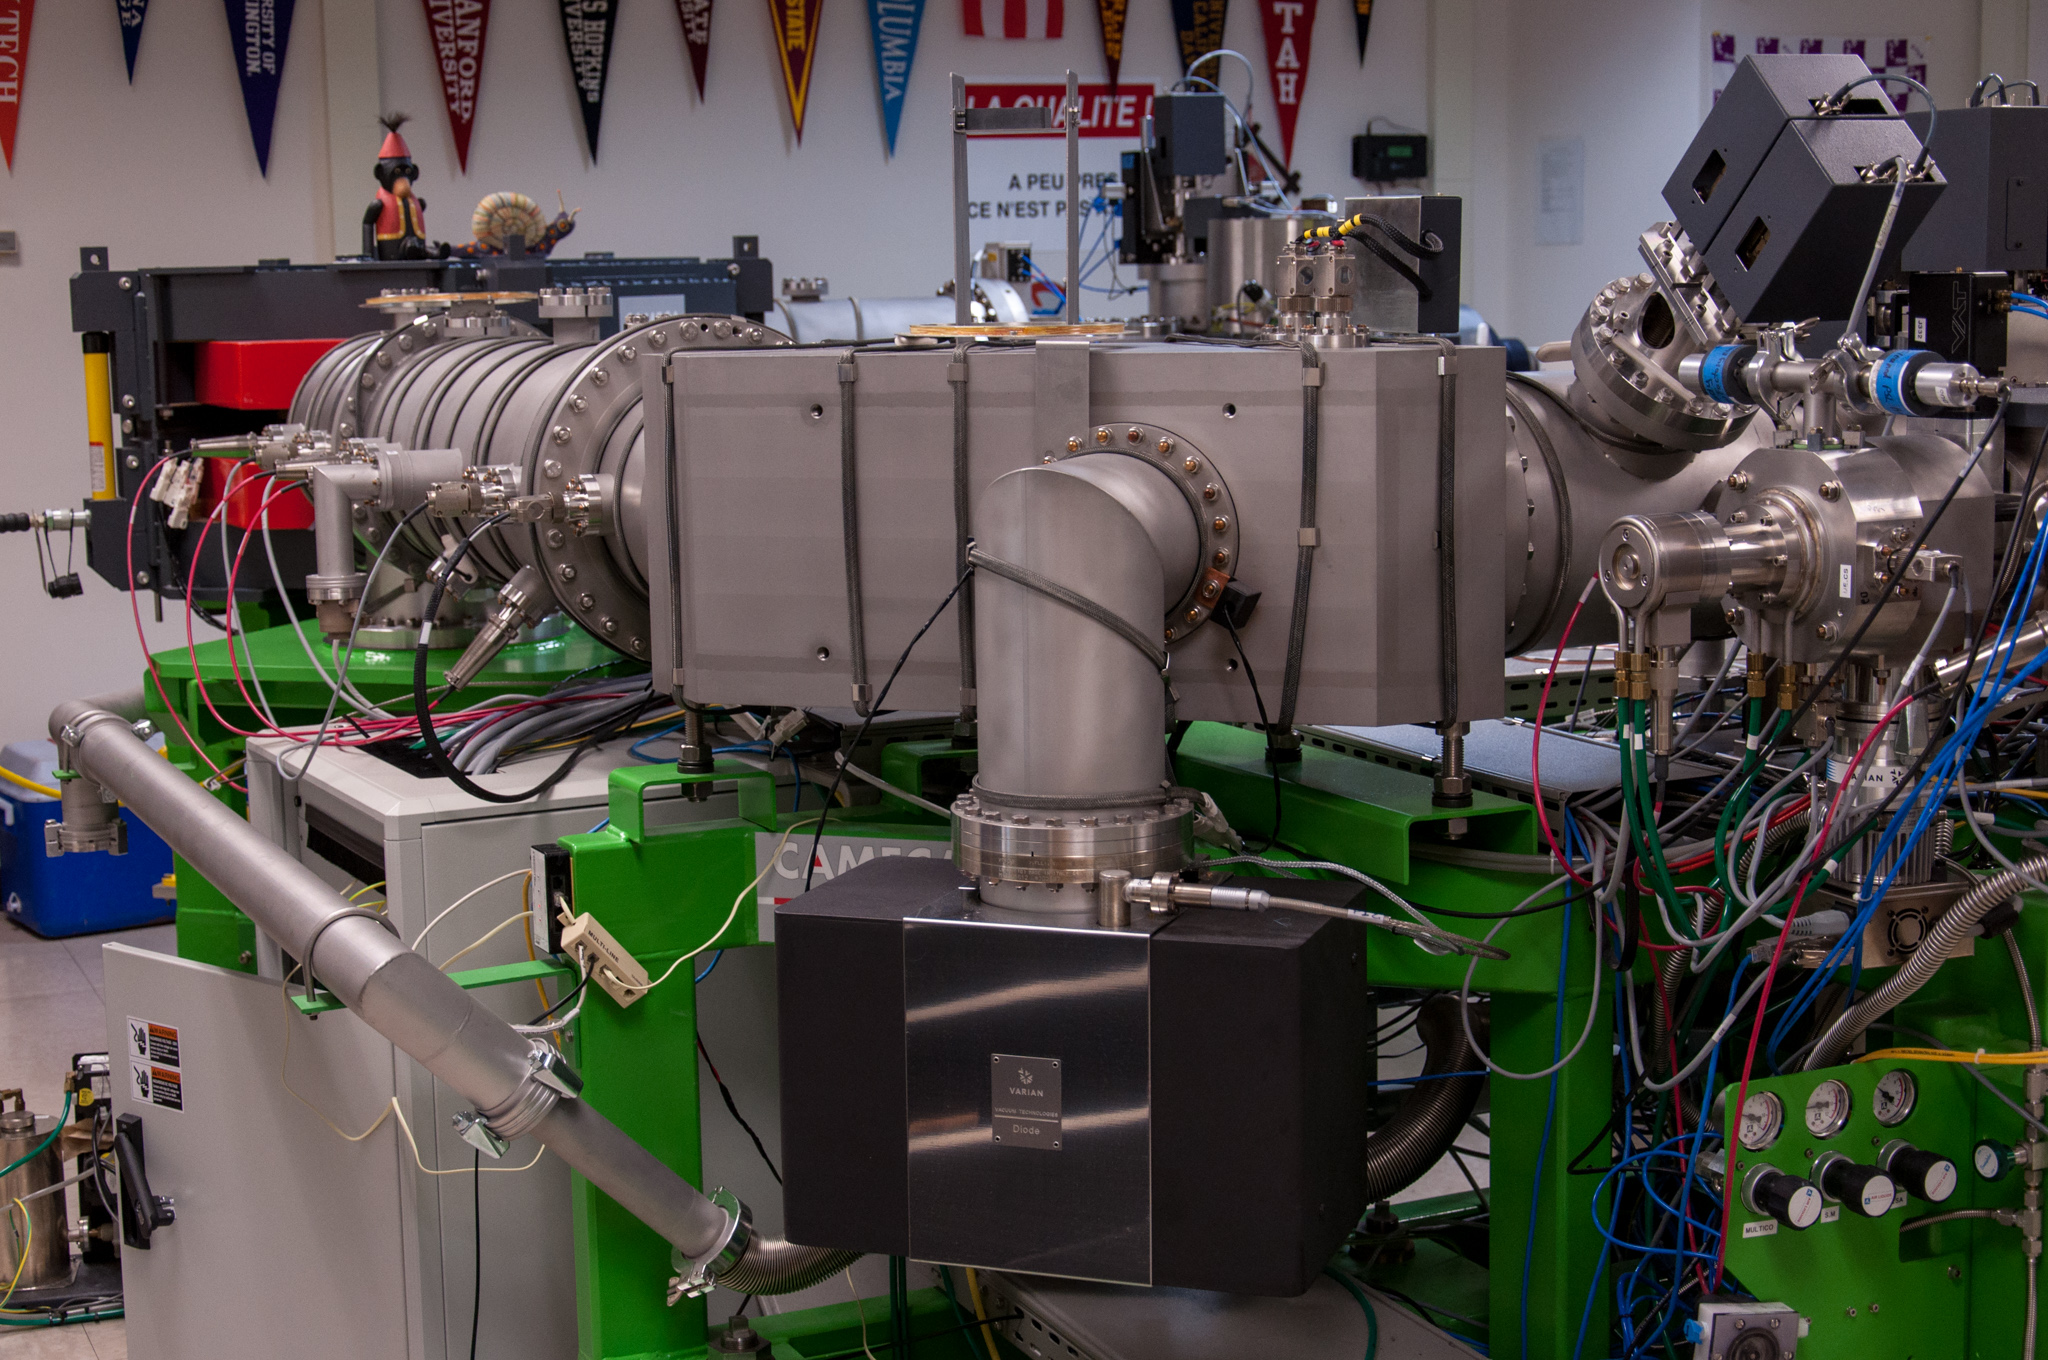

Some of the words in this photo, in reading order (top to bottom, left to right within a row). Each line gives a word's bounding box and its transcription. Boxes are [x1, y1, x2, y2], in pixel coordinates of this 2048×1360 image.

[262, 51, 275, 75] OF
[1008, 173, 1022, 190] A
[1027, 173, 1065, 190] PEU
[997, 201, 1050, 218] N'EST
[1056, 200, 1090, 217] PS
[1952, 280, 1966, 354] VAT
[773, 842, 952, 881] CAM
[588, 930, 620, 964] MULTI-LINE
[1009, 1087, 1044, 1097] VARIAN
[1012, 1124, 1040, 1135] Diode
[1745, 1224, 1774, 1234] MULTICO
